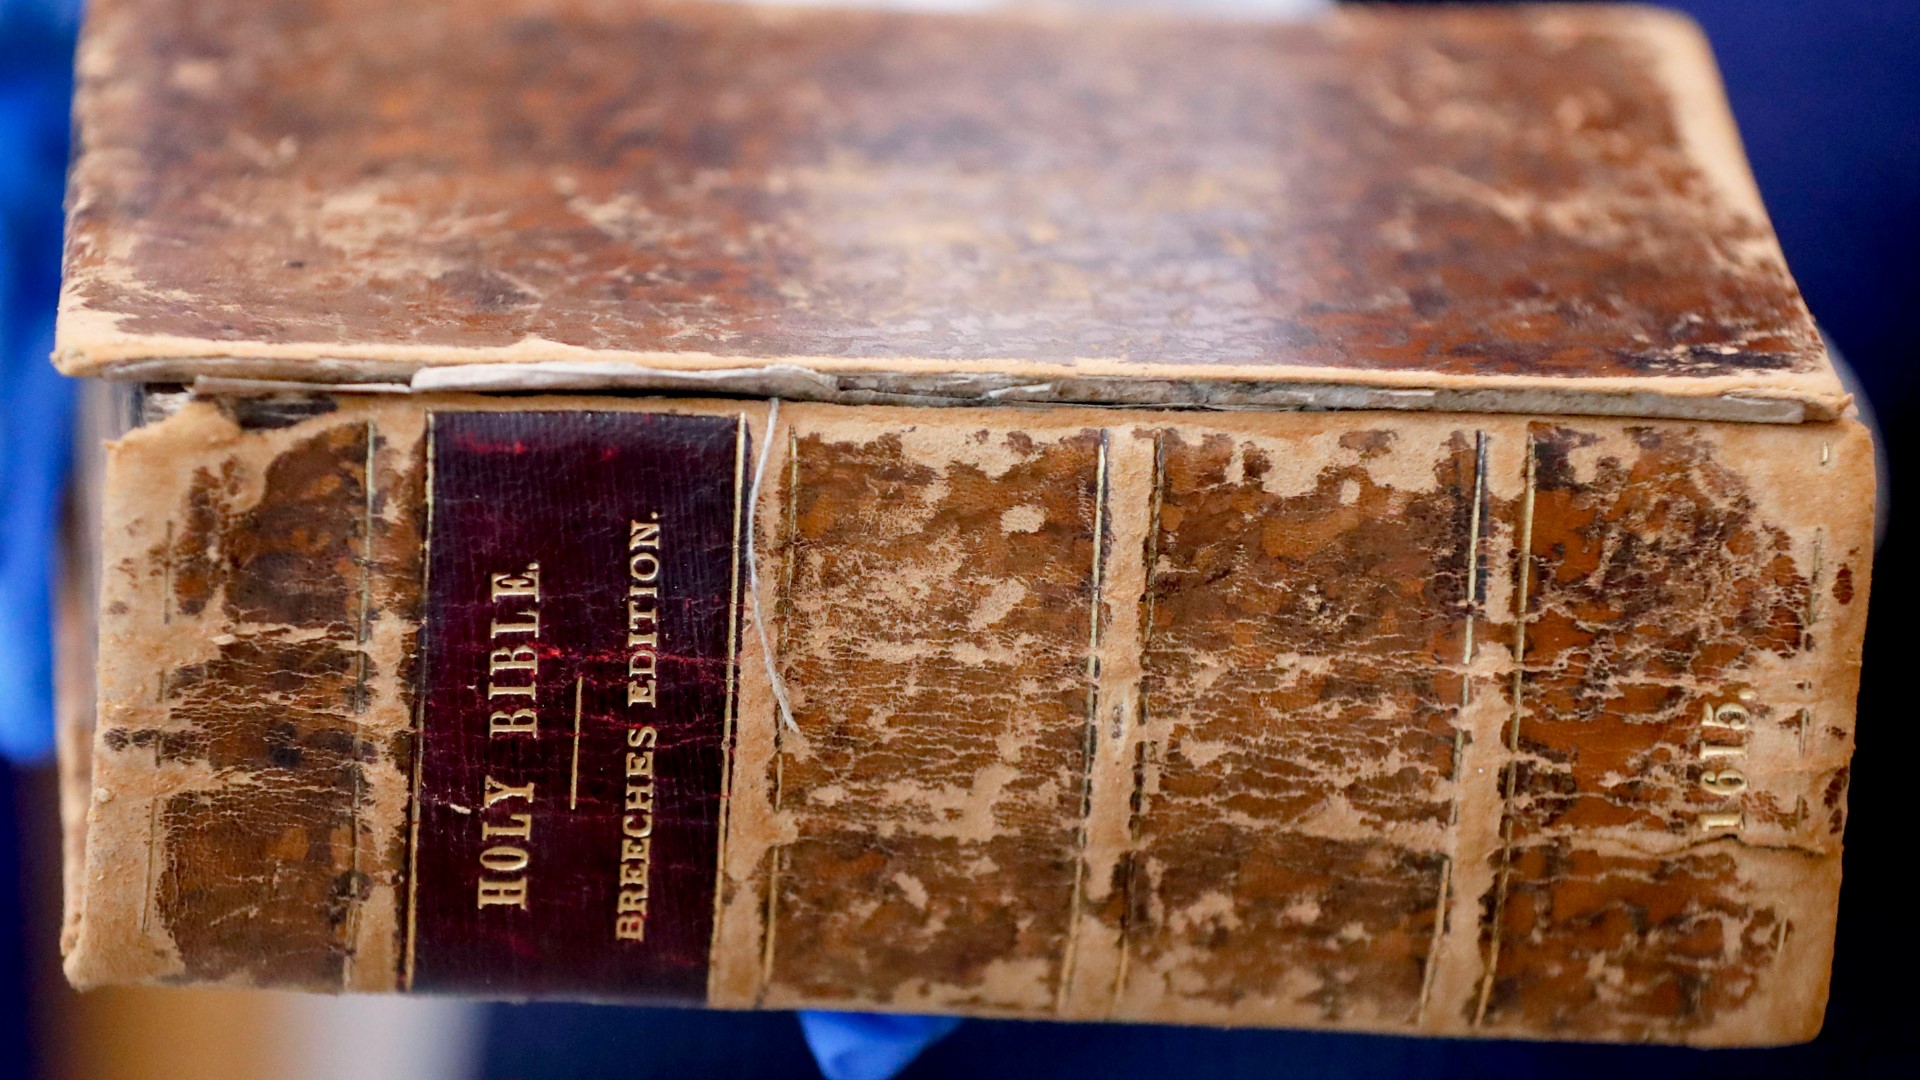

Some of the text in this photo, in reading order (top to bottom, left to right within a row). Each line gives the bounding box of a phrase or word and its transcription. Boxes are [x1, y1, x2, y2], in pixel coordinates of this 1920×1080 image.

[616, 511, 660, 942] BREECHES EDITION.
[1700, 690, 1754, 832] 1615.
[478, 774, 535, 910] HOLY
